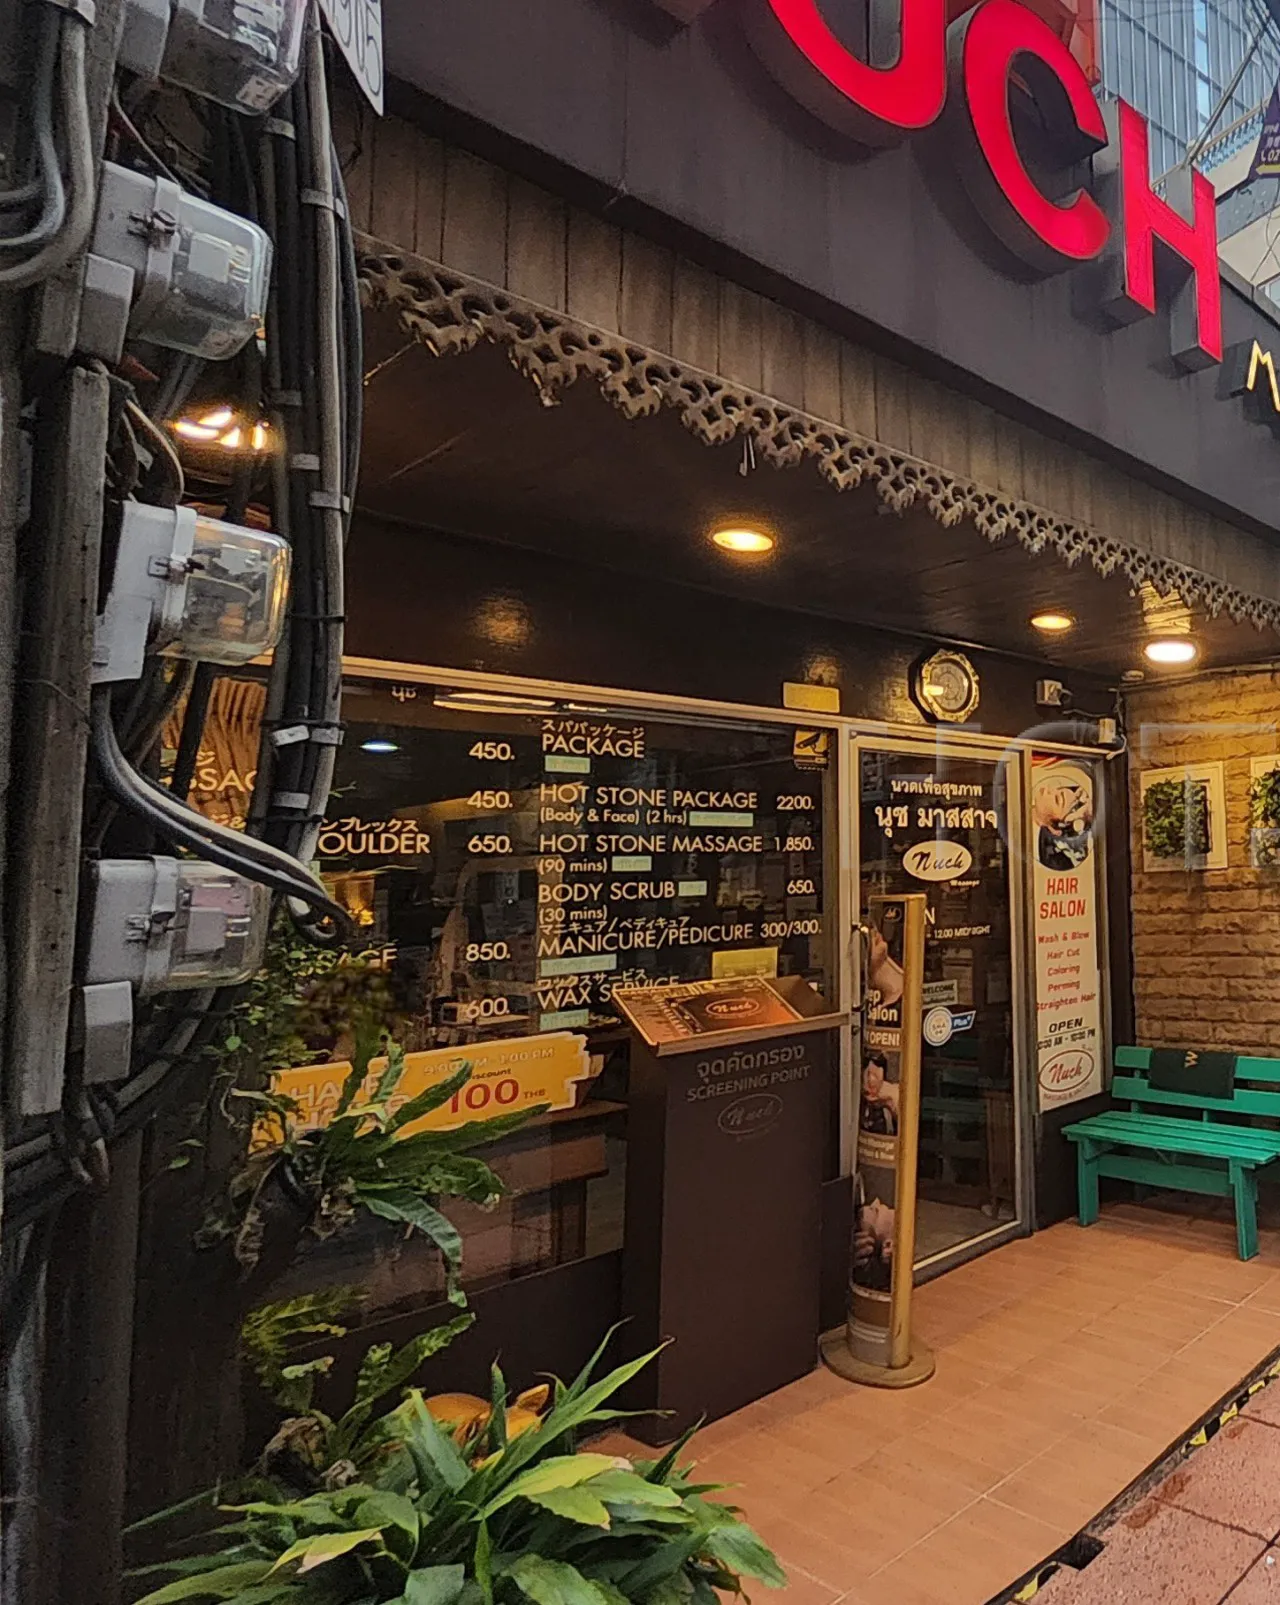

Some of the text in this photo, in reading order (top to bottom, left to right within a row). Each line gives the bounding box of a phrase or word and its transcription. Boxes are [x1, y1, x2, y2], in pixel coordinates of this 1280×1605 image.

[468, 742, 515, 761] 450.
[542, 732, 645, 758] PACKAGE
[467, 791, 513, 809] 450.
[540, 783, 757, 809] HOT STONE PACKAGE
[777, 796, 816, 810] 2200.
[540, 809, 583, 826] (Body
[587, 810, 599, 823] &
[603, 810, 640, 825] Face)
[646, 810, 658, 825] (2
[662, 810, 687, 826] hrs)
[875, 805, 908, 838] นุช
[318, 833, 431, 854] OULDER
[467, 835, 513, 853] 650.
[540, 835, 762, 853] HOT STONE MASSAGE
[774, 837, 815, 852] 1,850.
[538, 859, 565, 875] (90
[570, 859, 607, 873] mins)
[911, 851, 965, 872] Nuch
[538, 883, 602, 903] BODY
[610, 882, 675, 900] SCRUB
[787, 880, 815, 895] 650.
[1046, 877, 1079, 896] HAIR
[539, 905, 607, 922] (30 mins)
[1039, 898, 1086, 919] SALON
[538, 922, 753, 956] MANICURE/PEDICURE
[466, 942, 511, 962] 850.
[537, 986, 592, 1010] WAX
[466, 998, 511, 1019] 600.
[1049, 1017, 1083, 1033] OPEN
[687, 1065, 811, 1102] SCREENING POINT
[450, 1079, 519, 1114] 100
